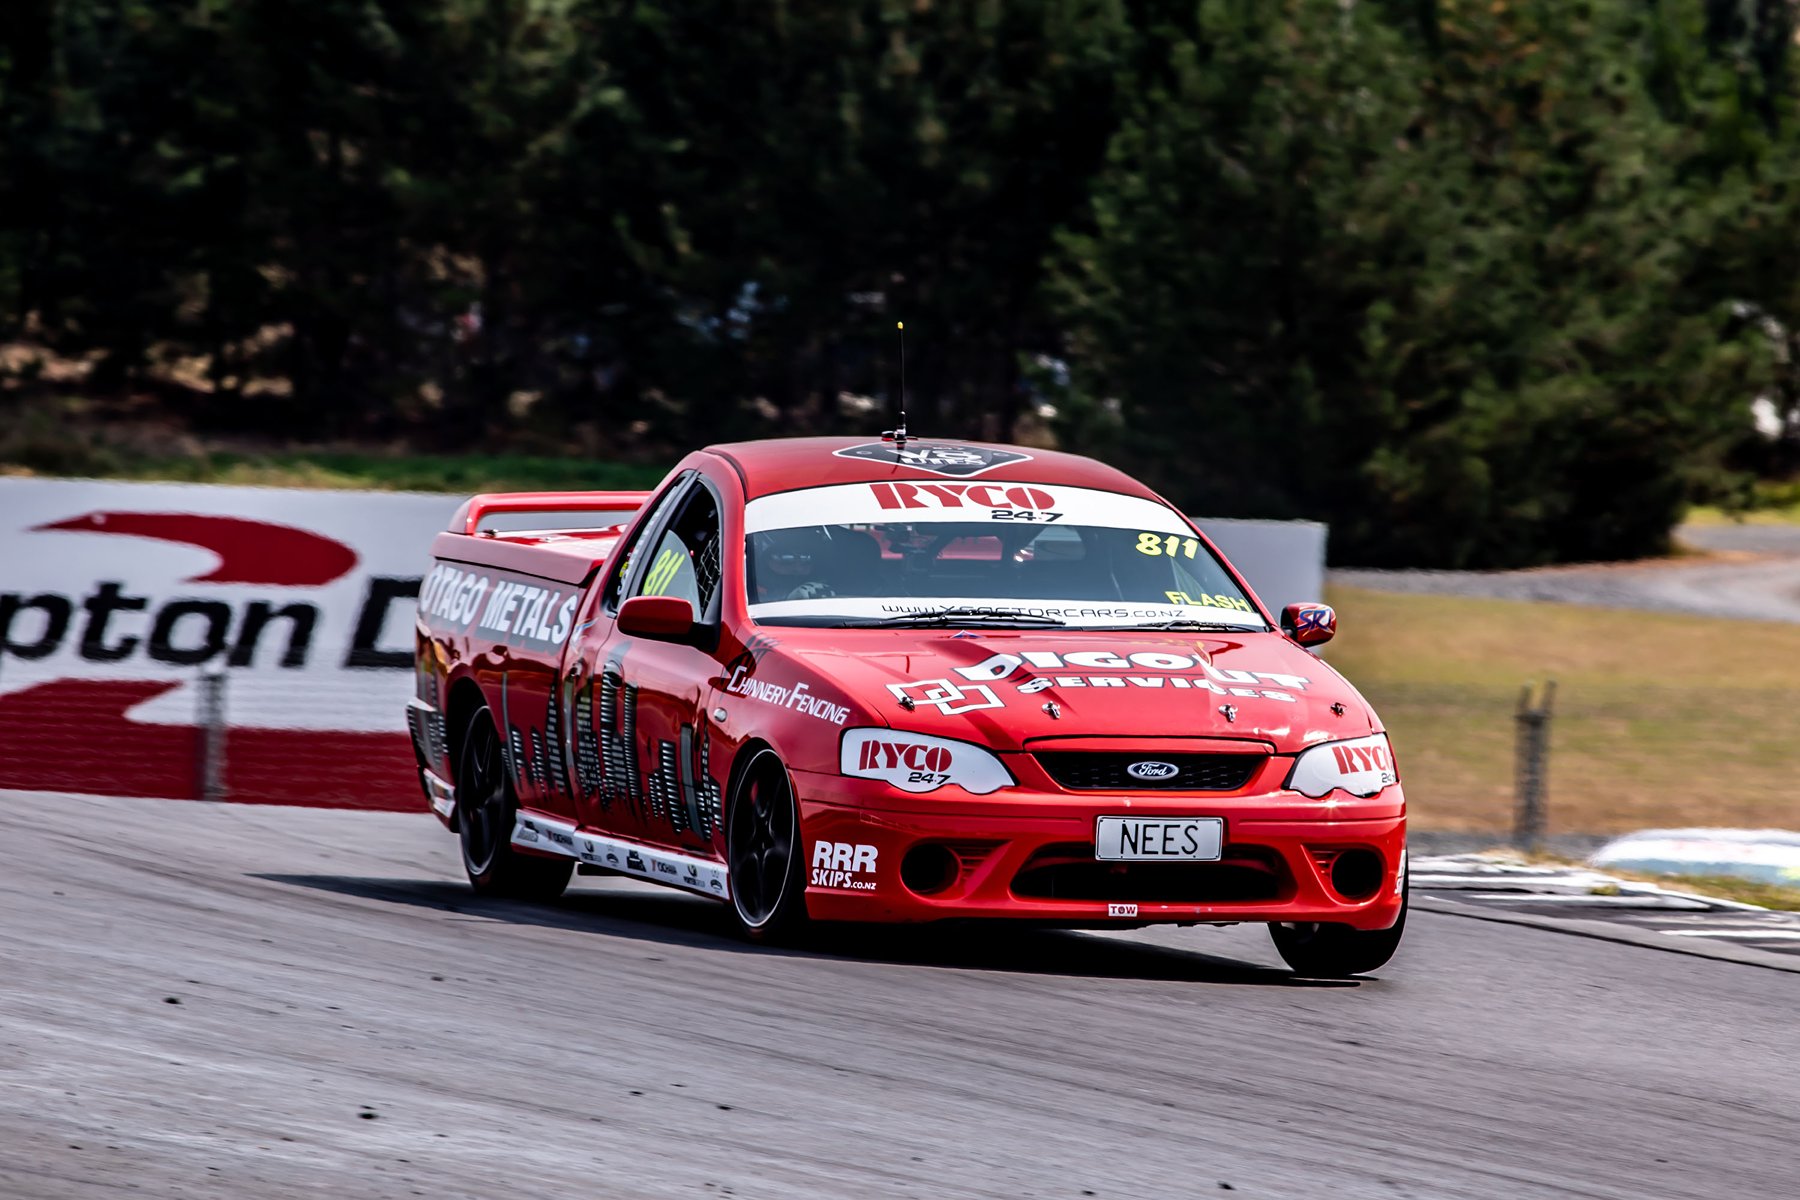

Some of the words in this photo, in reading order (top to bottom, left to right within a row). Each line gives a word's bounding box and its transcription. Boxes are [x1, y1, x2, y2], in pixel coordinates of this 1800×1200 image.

[869, 482, 1055, 511] RYCO
[1135, 532, 1199, 560] 811
[643, 548, 686, 597] 811
[420, 563, 489, 626] OTAGO
[479, 580, 578, 645] METALS
[1164, 591, 1253, 613] FLASH
[726, 665, 791, 706] CHINNERY
[785, 681, 851, 725] FENCING
[1014, 676, 1297, 703] SERVICES
[859, 740, 952, 772] RYCO
[1138, 763, 1168, 776] Ford
[1120, 823, 1199, 855] NEES
[812, 840, 879, 873] RRR
[811, 868, 877, 890] SKIPS.CO.NZ
[1110, 905, 1136, 915] TOW
